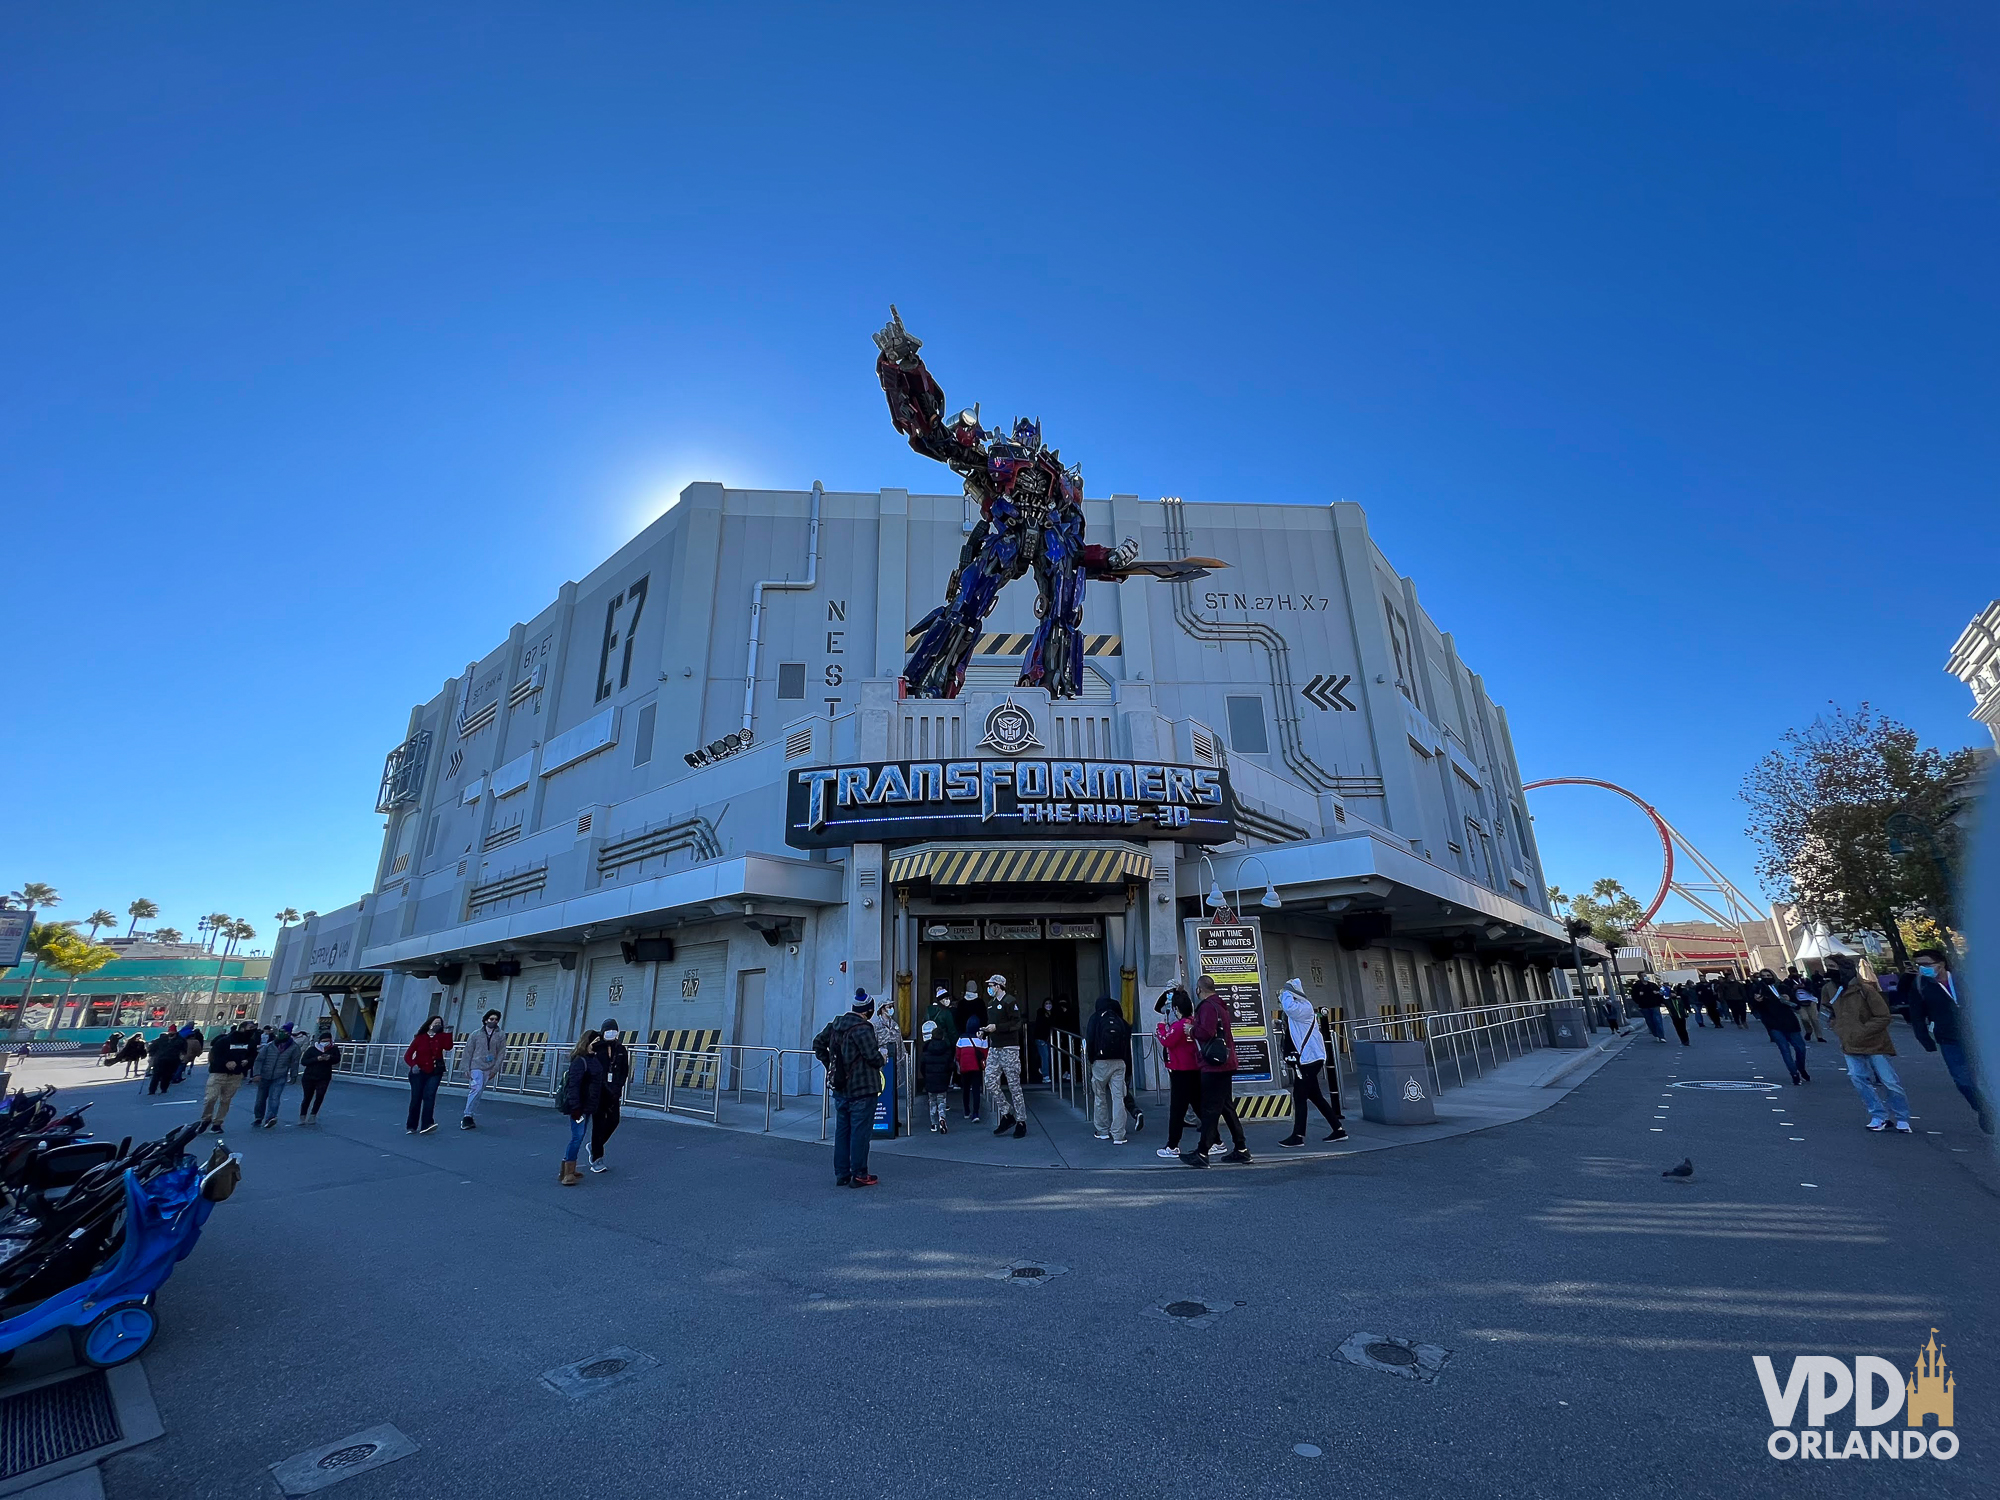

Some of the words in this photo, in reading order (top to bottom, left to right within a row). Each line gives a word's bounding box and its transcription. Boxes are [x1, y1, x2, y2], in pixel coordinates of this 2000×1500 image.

[595, 574, 650, 704] E7
[823, 600, 846, 717] NEST
[798, 761, 1223, 831] TRANSFORMERS
[1017, 804, 1072, 823] THE
[1068, 925, 1094, 933] ENTRANCE
[1209, 930, 1225, 938] WAIT
[1208, 939, 1218, 947] 20
[1222, 938, 1251, 946] MINUTES
[1212, 956, 1247, 965] WARNING
[684, 968, 699, 979] NEST
